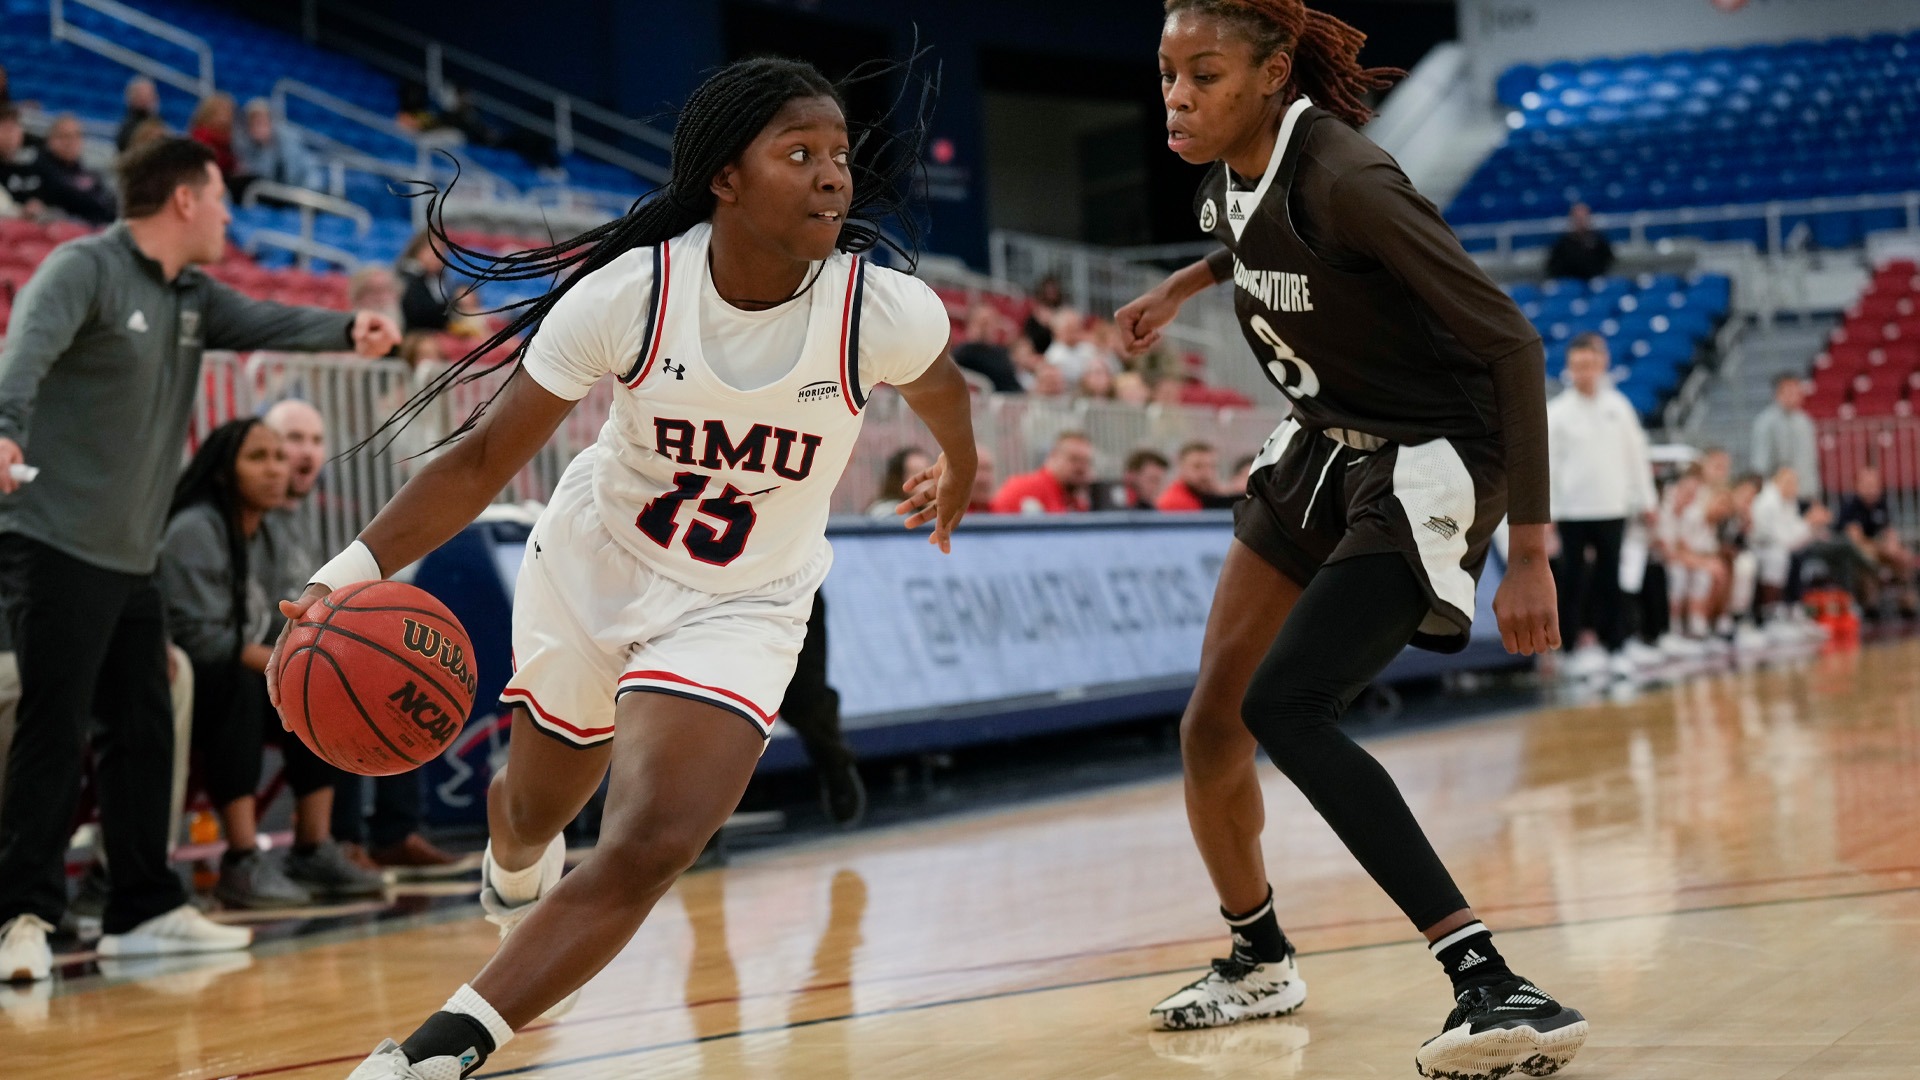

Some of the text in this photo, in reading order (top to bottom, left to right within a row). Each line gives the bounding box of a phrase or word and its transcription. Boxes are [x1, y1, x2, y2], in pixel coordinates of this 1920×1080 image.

[1250, 314, 1320, 399] 3
[797, 393, 839, 403] LEAGUE
[798, 385, 838, 398] HORIZON
[653, 416, 823, 481] RMU
[635, 471, 768, 567] 15
[403, 617, 477, 702] Wilso
[388, 680, 458, 747] NCAA
[1458, 955, 1487, 971] adidas
